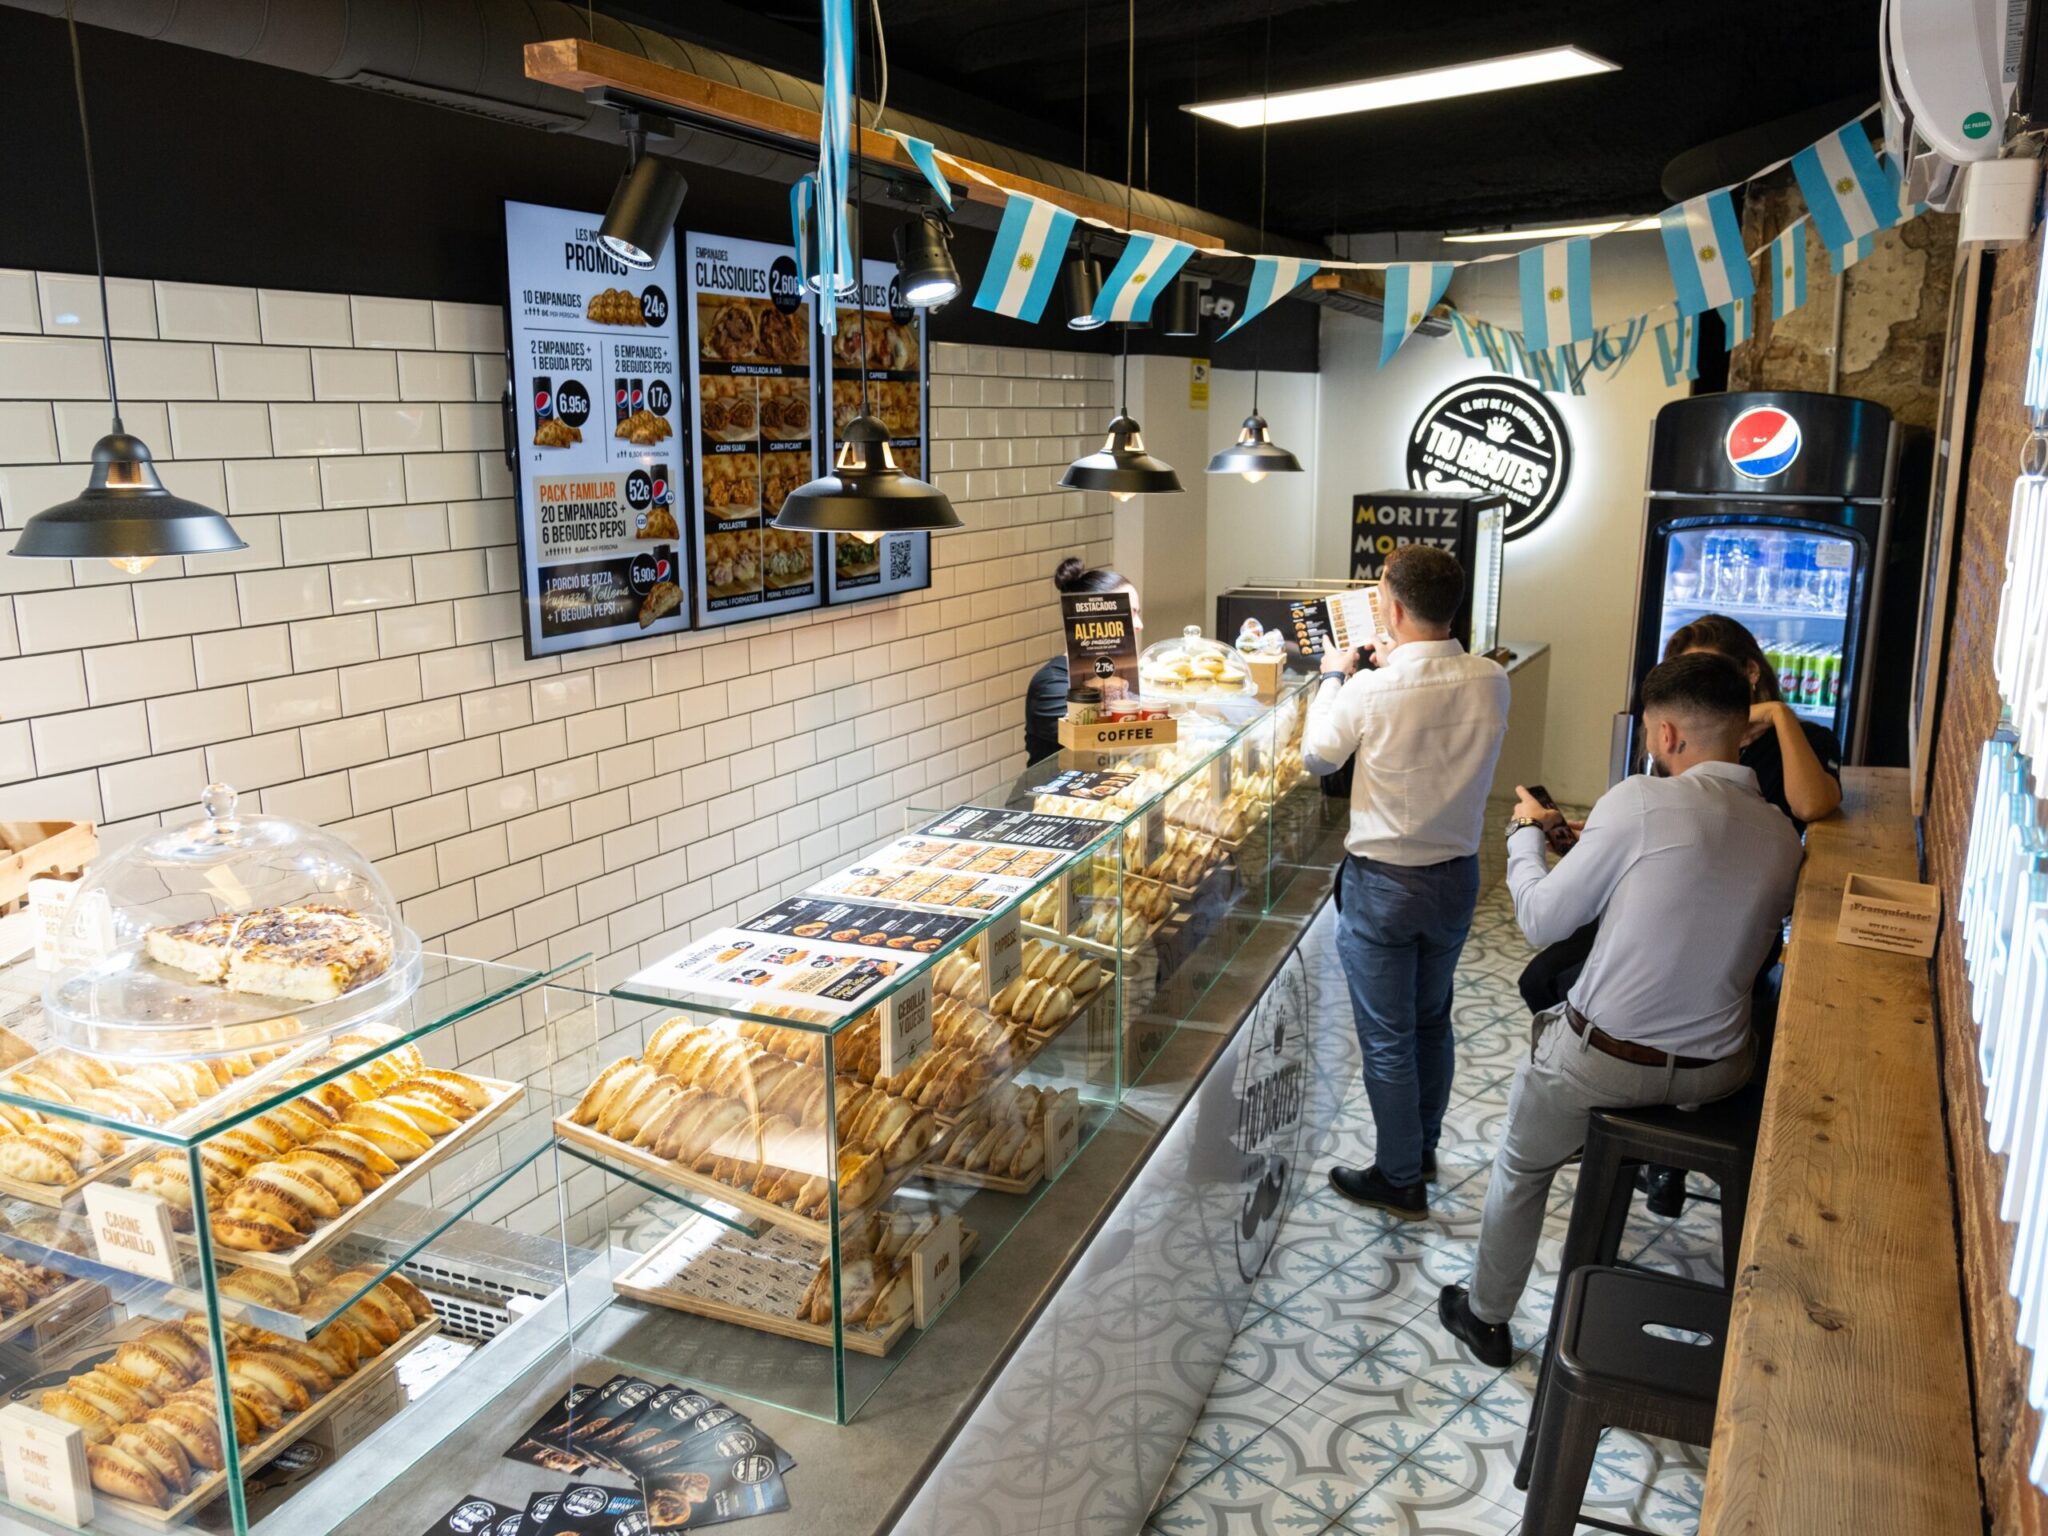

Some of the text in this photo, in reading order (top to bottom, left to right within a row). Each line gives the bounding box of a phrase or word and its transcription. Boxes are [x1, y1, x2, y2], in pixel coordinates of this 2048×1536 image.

[576, 228, 588, 242] LES
[696, 247, 728, 261] EMPANADES
[695, 256, 766, 294] CLÀSSIQUES
[523, 290, 582, 309] 10 EMPANADES
[644, 295, 666, 318] 24€
[531, 341, 537, 354] 2
[538, 342, 585, 357] EMPANADES
[615, 345, 620, 358] 6
[621, 346, 662, 359] EMPANADES
[533, 357, 592, 372] 1 BEGUDA PEPSI
[616, 360, 672, 374] 2 BEGUDES PEPSI
[559, 393, 588, 414] 6.95€
[651, 387, 669, 407] 17€
[1501, 400, 1513, 413] LA
[716, 444, 731, 452] CARN
[1426, 421, 1548, 497] TIO BIGOTES
[540, 481, 616, 502] PACK FAMILIAR
[629, 479, 650, 501] 52€
[541, 506, 555, 523] 20
[558, 501, 618, 521] EMPANADES
[1355, 504, 1458, 528] MORITZ
[542, 521, 626, 544] 6 BEGUDES PEPSI
[719, 520, 747, 530] POLLASTRE
[546, 572, 613, 592] 1 PORCIÓ DE PIZZA
[633, 566, 656, 583] 5.90€
[555, 611, 559, 624] 1
[561, 606, 592, 622] BEGUDA
[594, 601, 616, 617] PEPSI
[1075, 601, 1117, 612] DESTACADOS
[1075, 621, 1124, 640] ALFAJOR
[1095, 662, 1114, 673] 2.75€
[1097, 728, 1153, 742] COFFEE
[898, 987, 926, 1020] CEBOLLA
[905, 1006, 925, 1034] QUESO
[105, 1211, 143, 1235] CARNE
[102, 1227, 156, 1257] CUCHILLO
